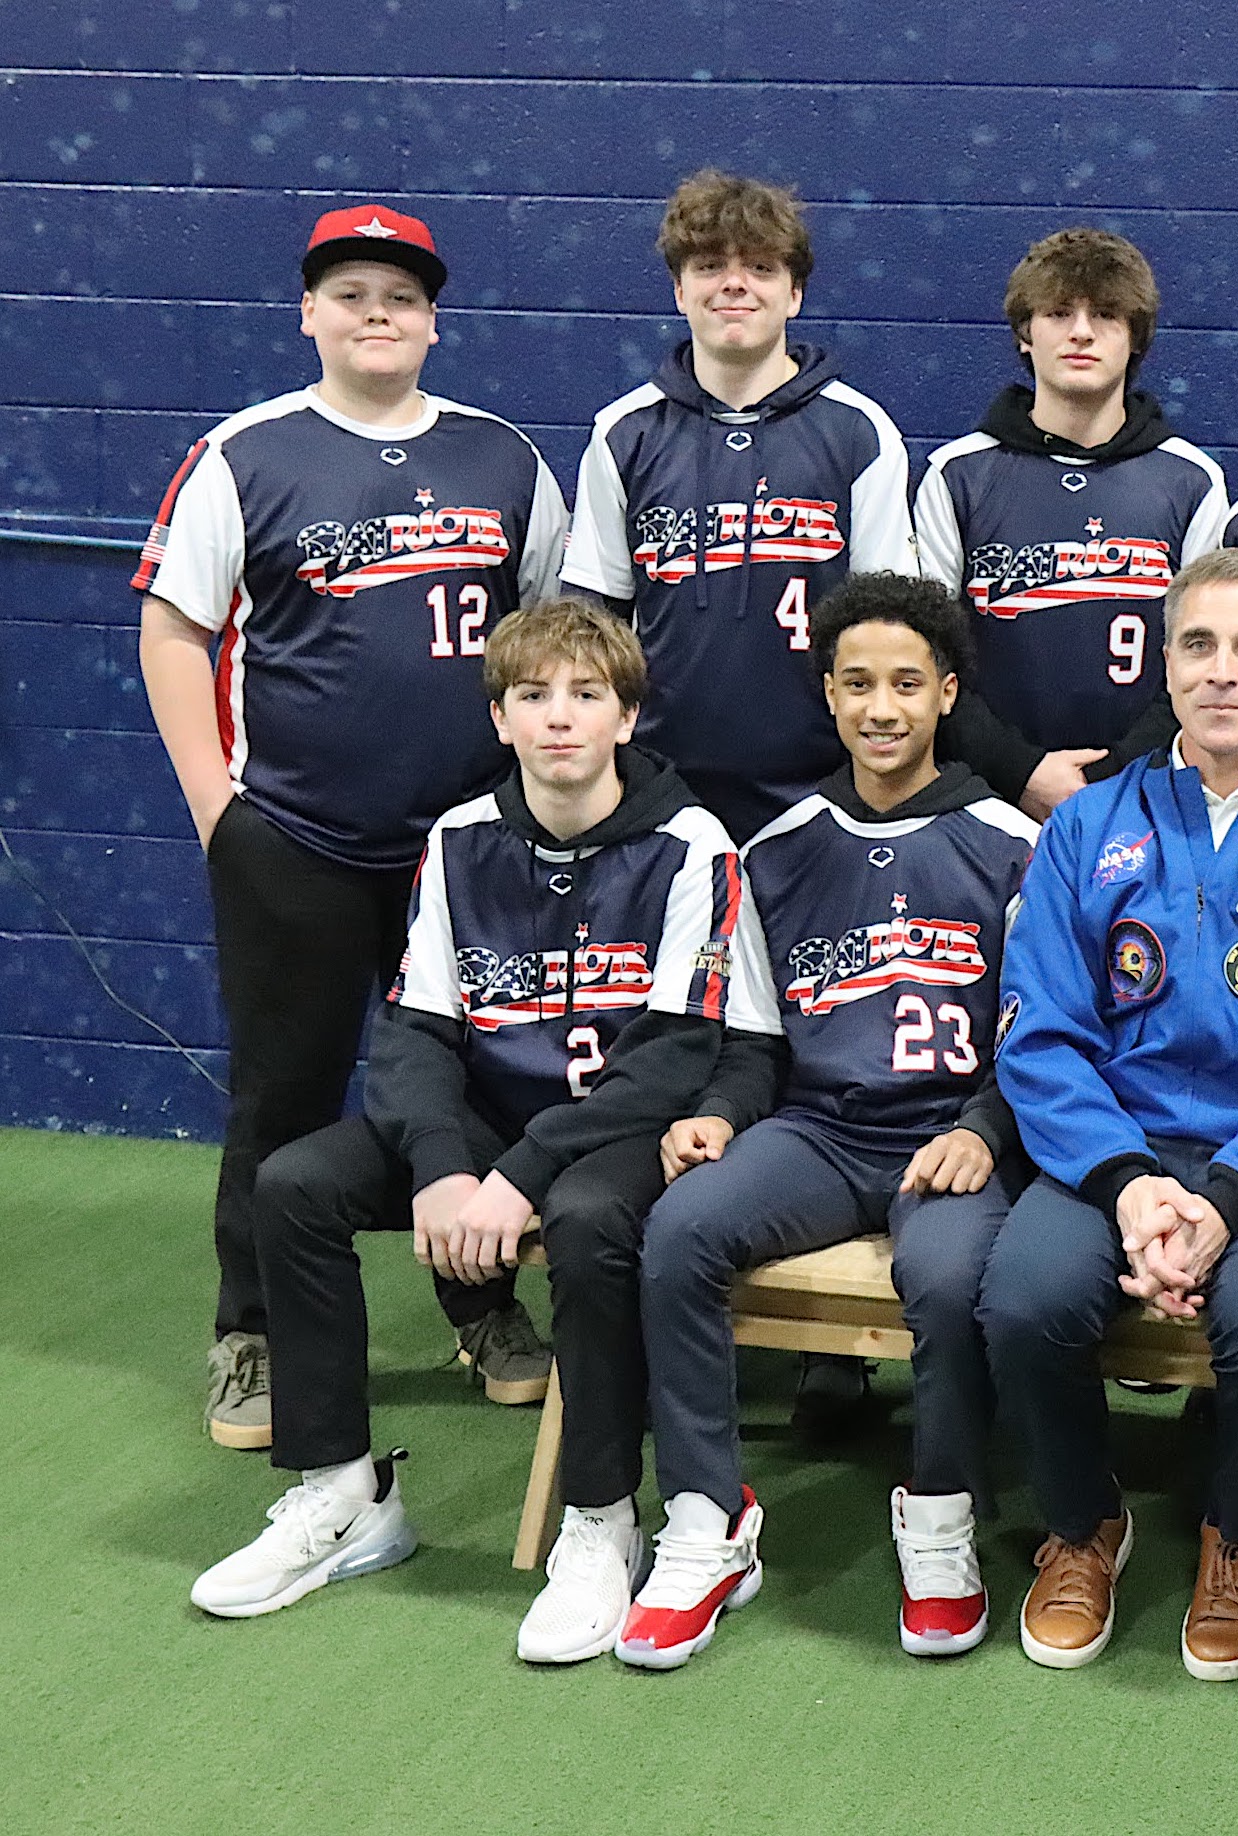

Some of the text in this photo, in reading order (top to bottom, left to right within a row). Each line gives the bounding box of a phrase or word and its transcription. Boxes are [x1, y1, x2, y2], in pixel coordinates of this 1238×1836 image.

[295, 506, 510, 598] PATRIOTS
[633, 497, 846, 584] PATRIOTS
[966, 537, 1175, 620] PATRIOTS
[426, 583, 489, 657] 12
[774, 576, 811, 651] 4
[1107, 613, 1146, 685] 9
[1098, 846, 1146, 871] NASA
[457, 941, 654, 1032] PATRIOTS
[785, 916, 988, 1017] PATRIOTS
[566, 1026, 607, 1098] 2
[891, 993, 979, 1076] 23
